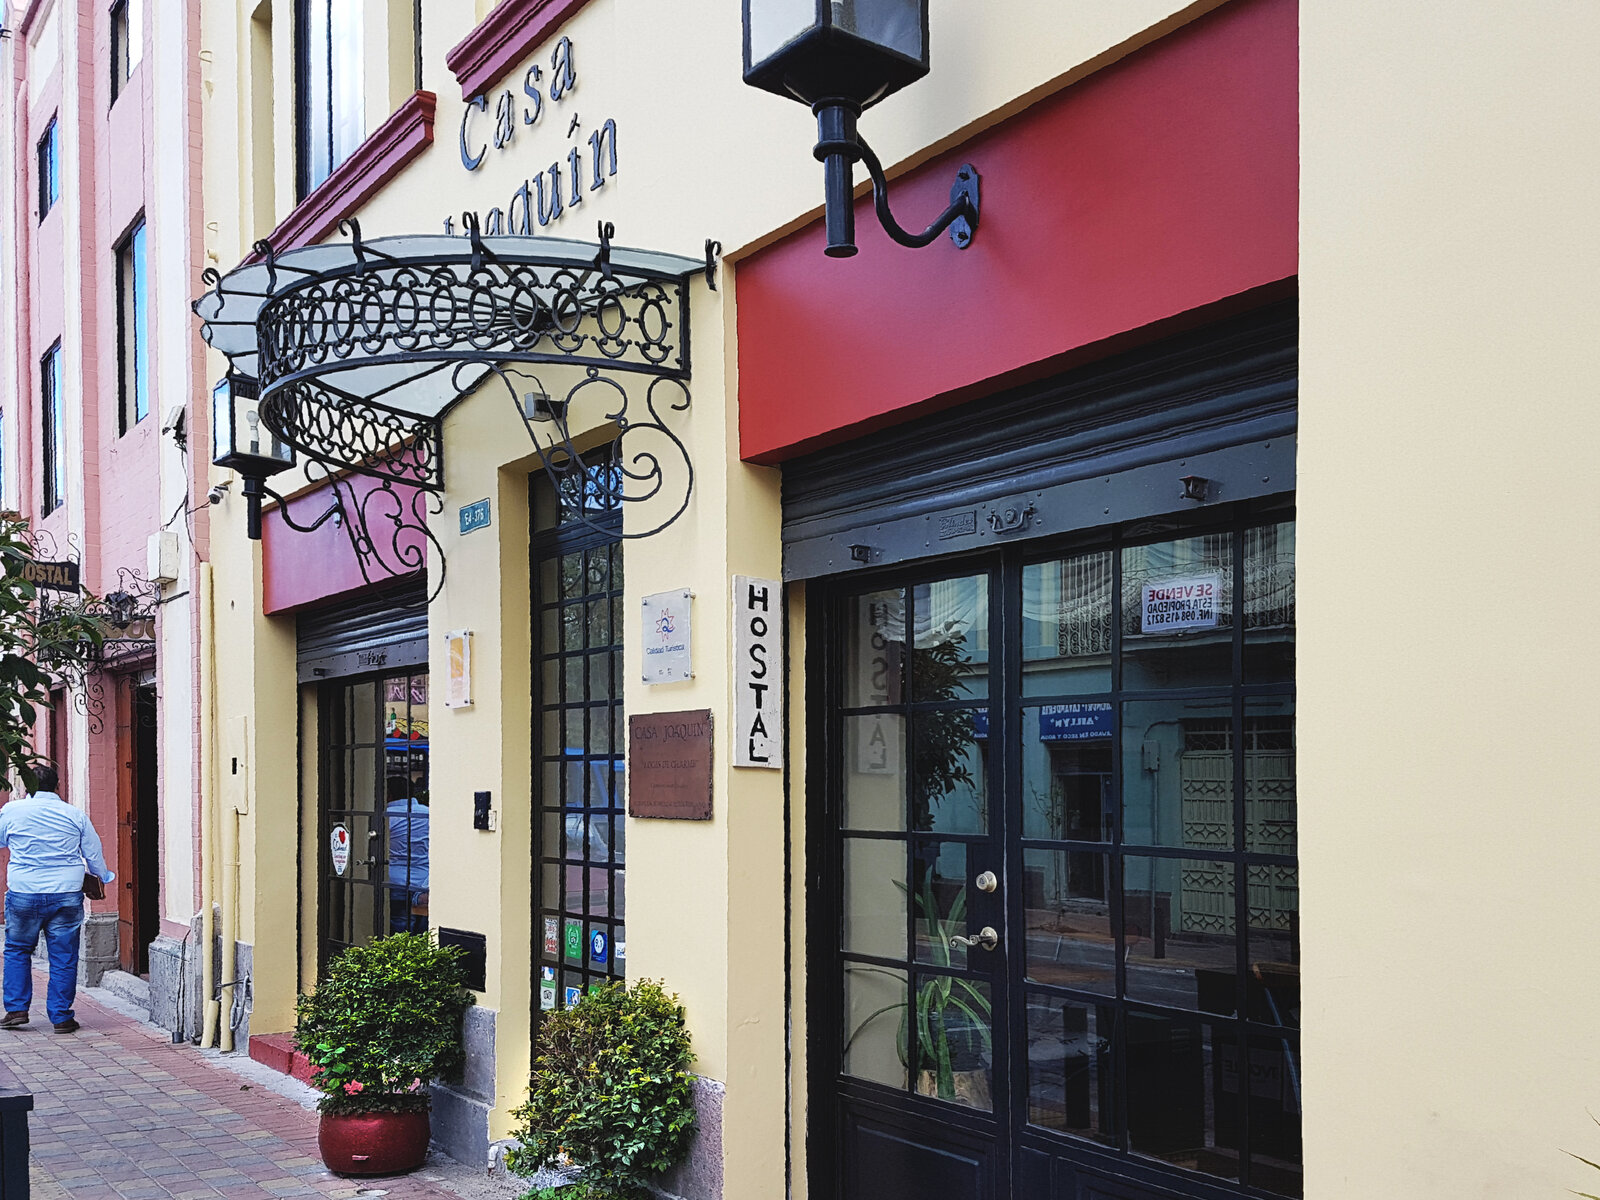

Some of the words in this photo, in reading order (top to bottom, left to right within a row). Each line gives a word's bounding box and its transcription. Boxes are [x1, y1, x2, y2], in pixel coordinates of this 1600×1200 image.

[459, 36, 577, 171] Casa
[19, 563, 72, 586] OSTAL
[748, 584, 769, 763] HOSTAL
[634, 726, 658, 740] CASA
